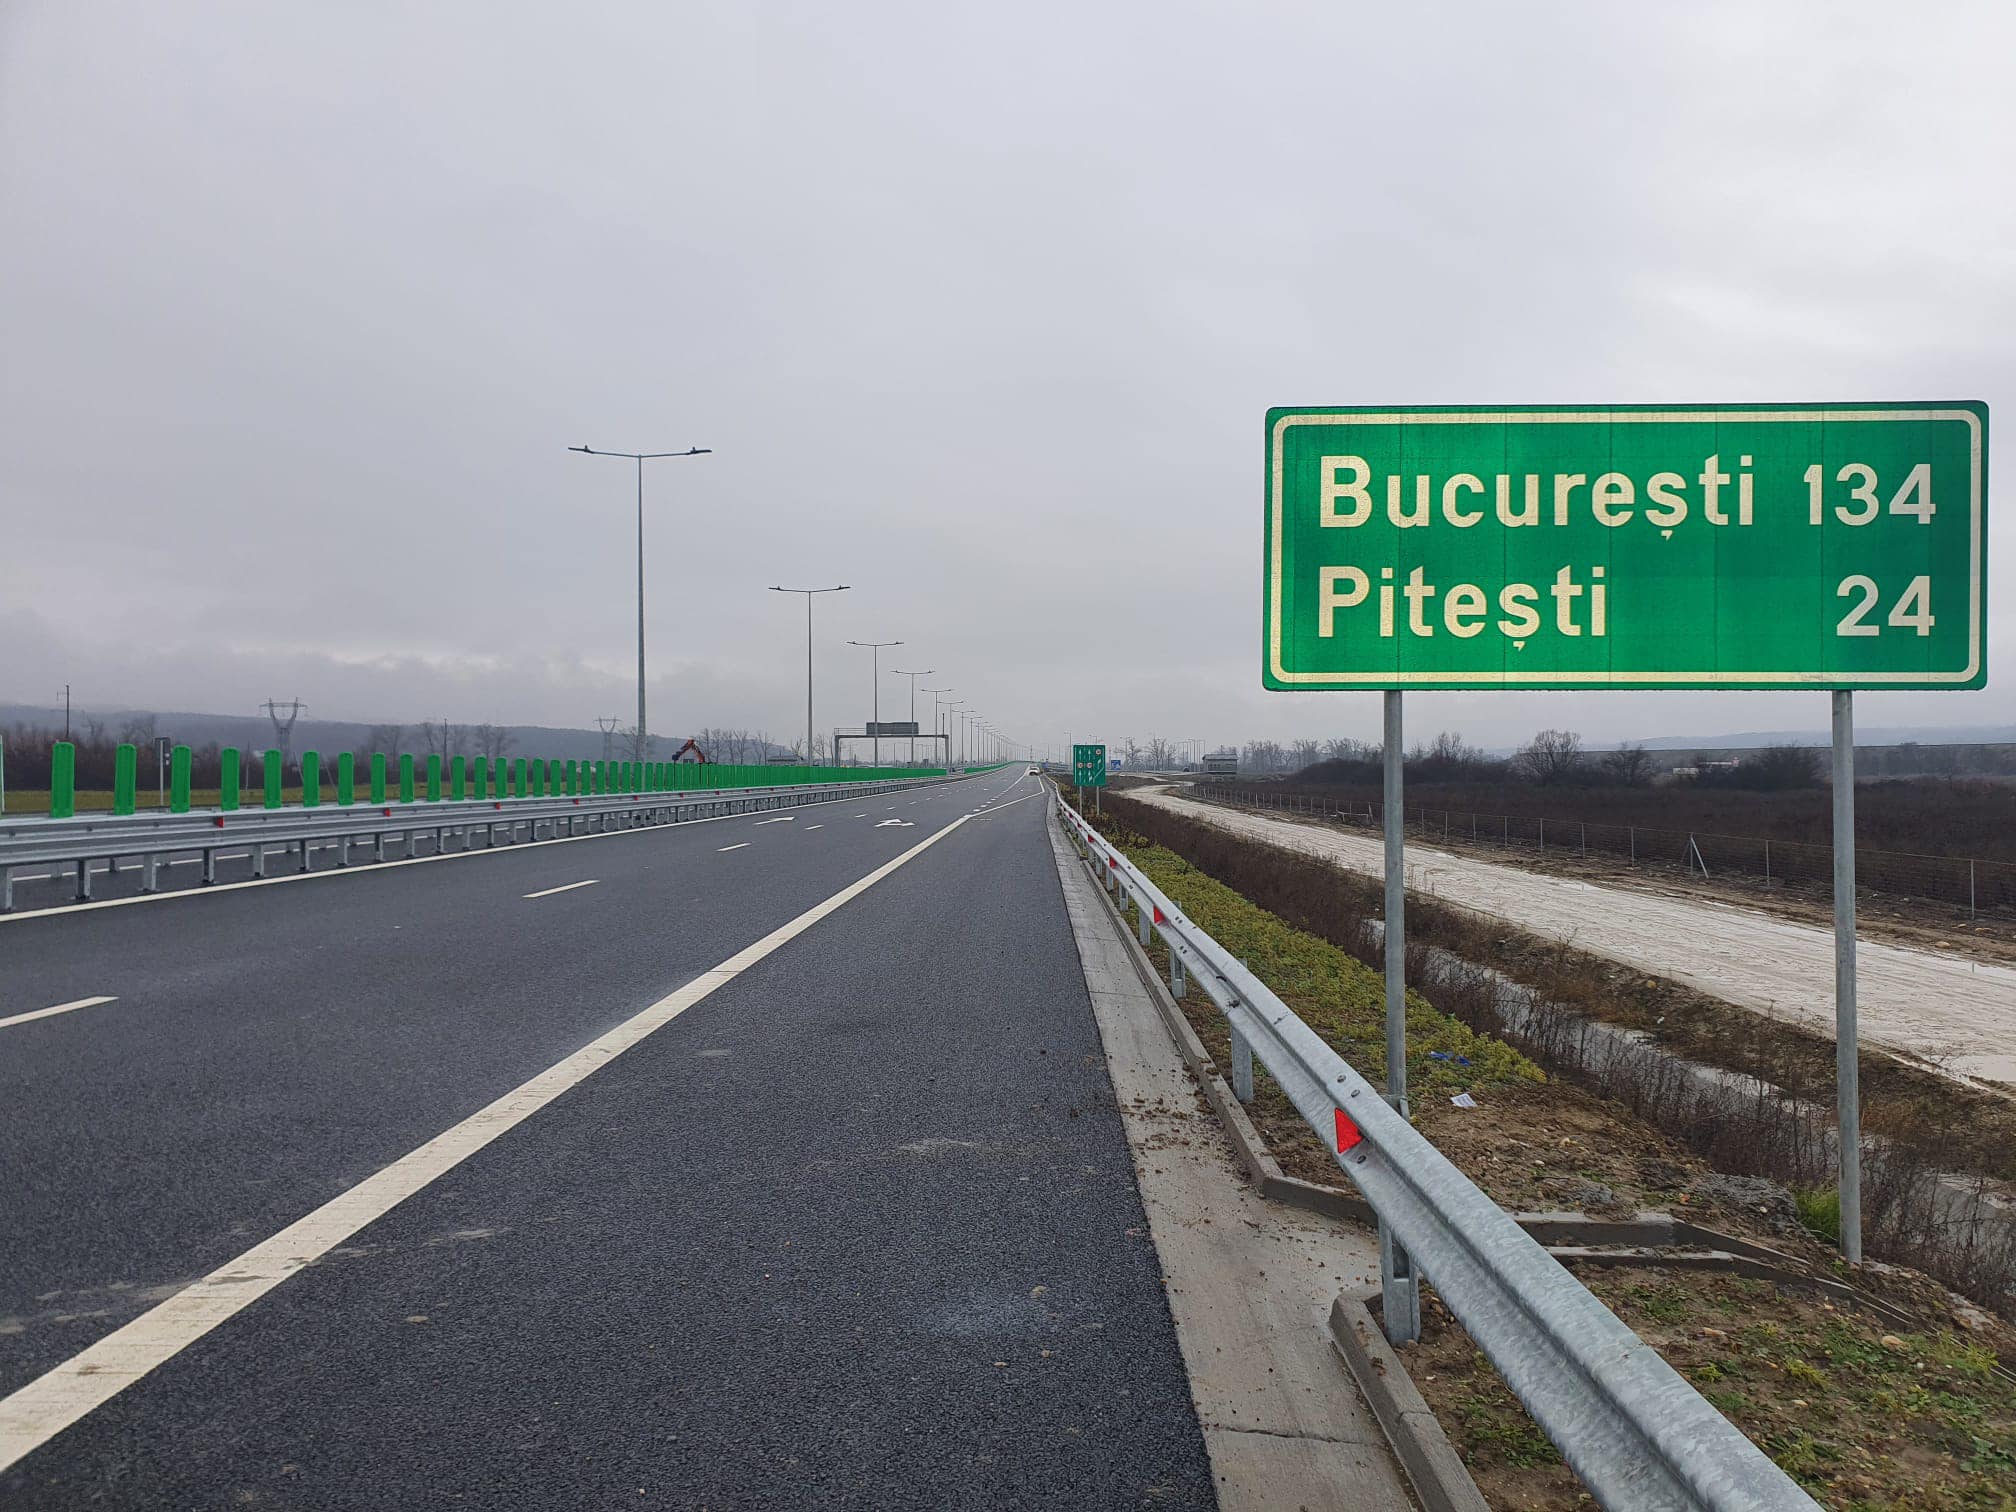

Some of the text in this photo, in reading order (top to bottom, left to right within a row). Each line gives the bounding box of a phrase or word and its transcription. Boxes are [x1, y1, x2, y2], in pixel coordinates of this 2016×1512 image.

[1319, 455, 1936, 540] București 134
[1318, 565, 1935, 651] Pitești 24
